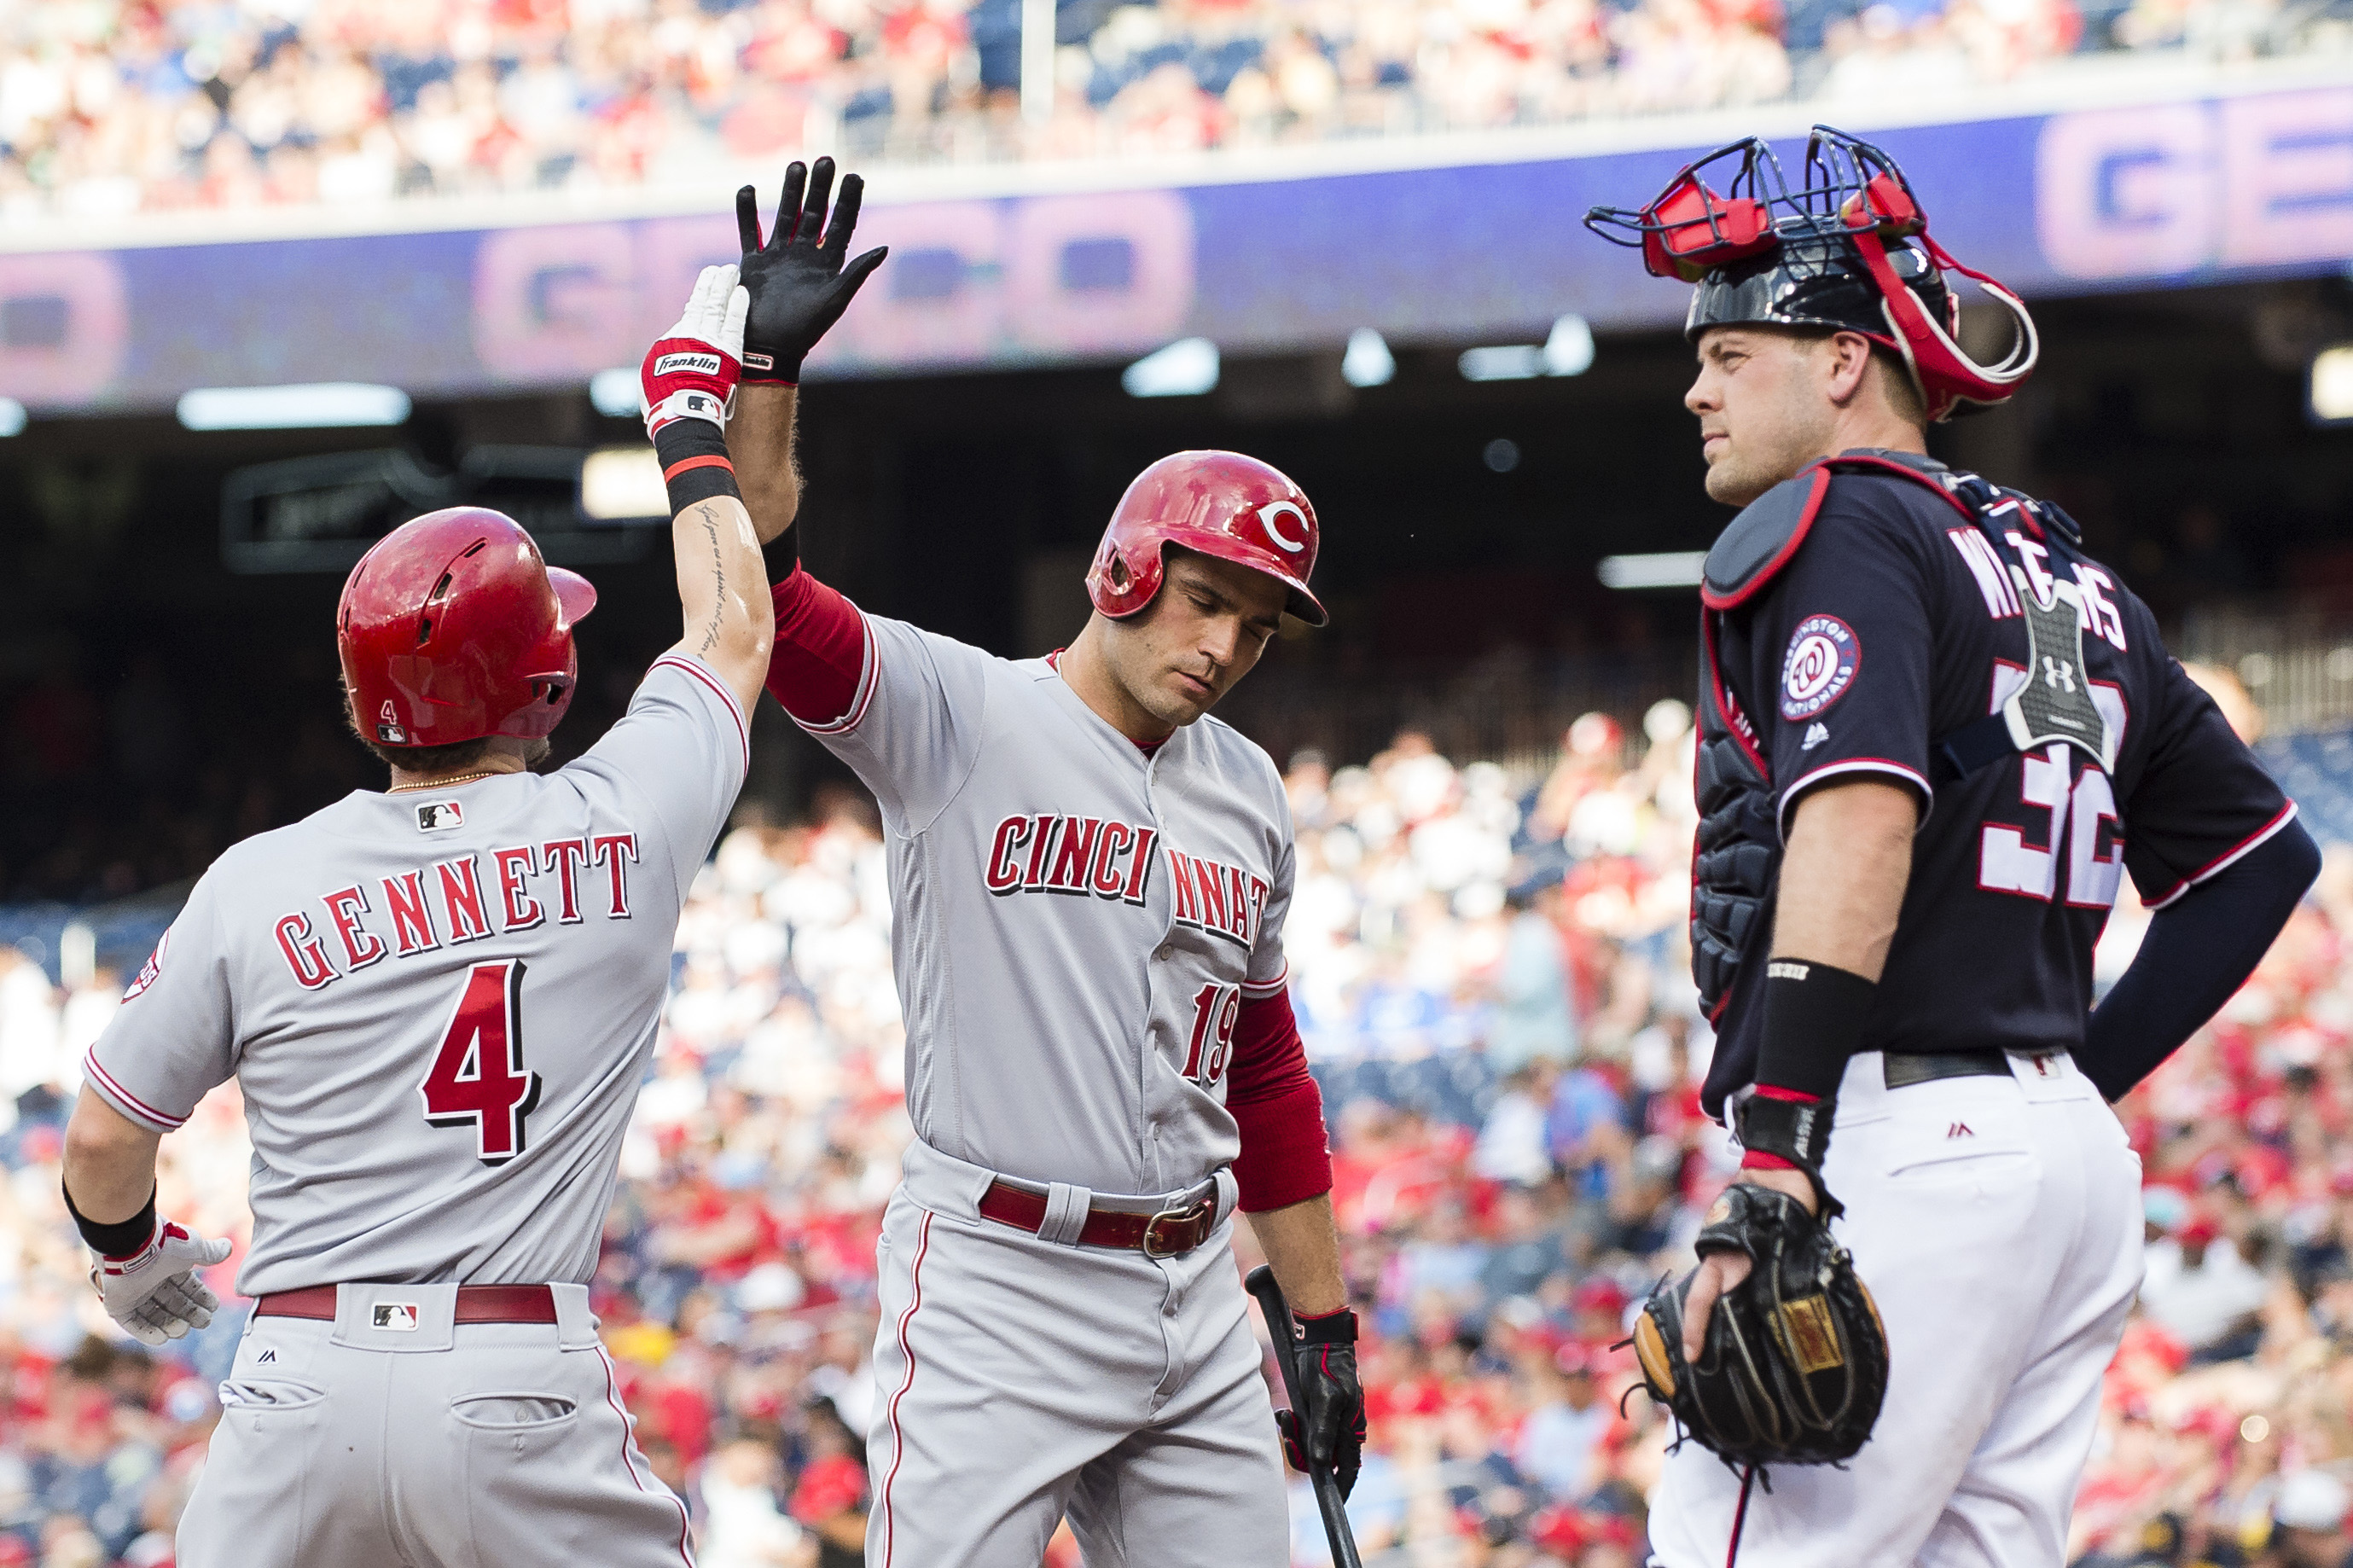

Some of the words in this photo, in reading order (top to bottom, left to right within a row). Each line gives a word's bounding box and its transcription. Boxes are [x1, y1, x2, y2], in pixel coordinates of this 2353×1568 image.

[657, 356, 718, 374] Franklin
[1256, 500, 1310, 554] C
[712, 570, 727, 602] spirit
[707, 622, 720, 633] of
[714, 601, 725, 623] not
[381, 699, 398, 726] 4
[984, 811, 1269, 955] CINCINNAT
[272, 831, 640, 991] GENNETT
[1180, 981, 1241, 1085] 19
[415, 957, 543, 1168] 4
